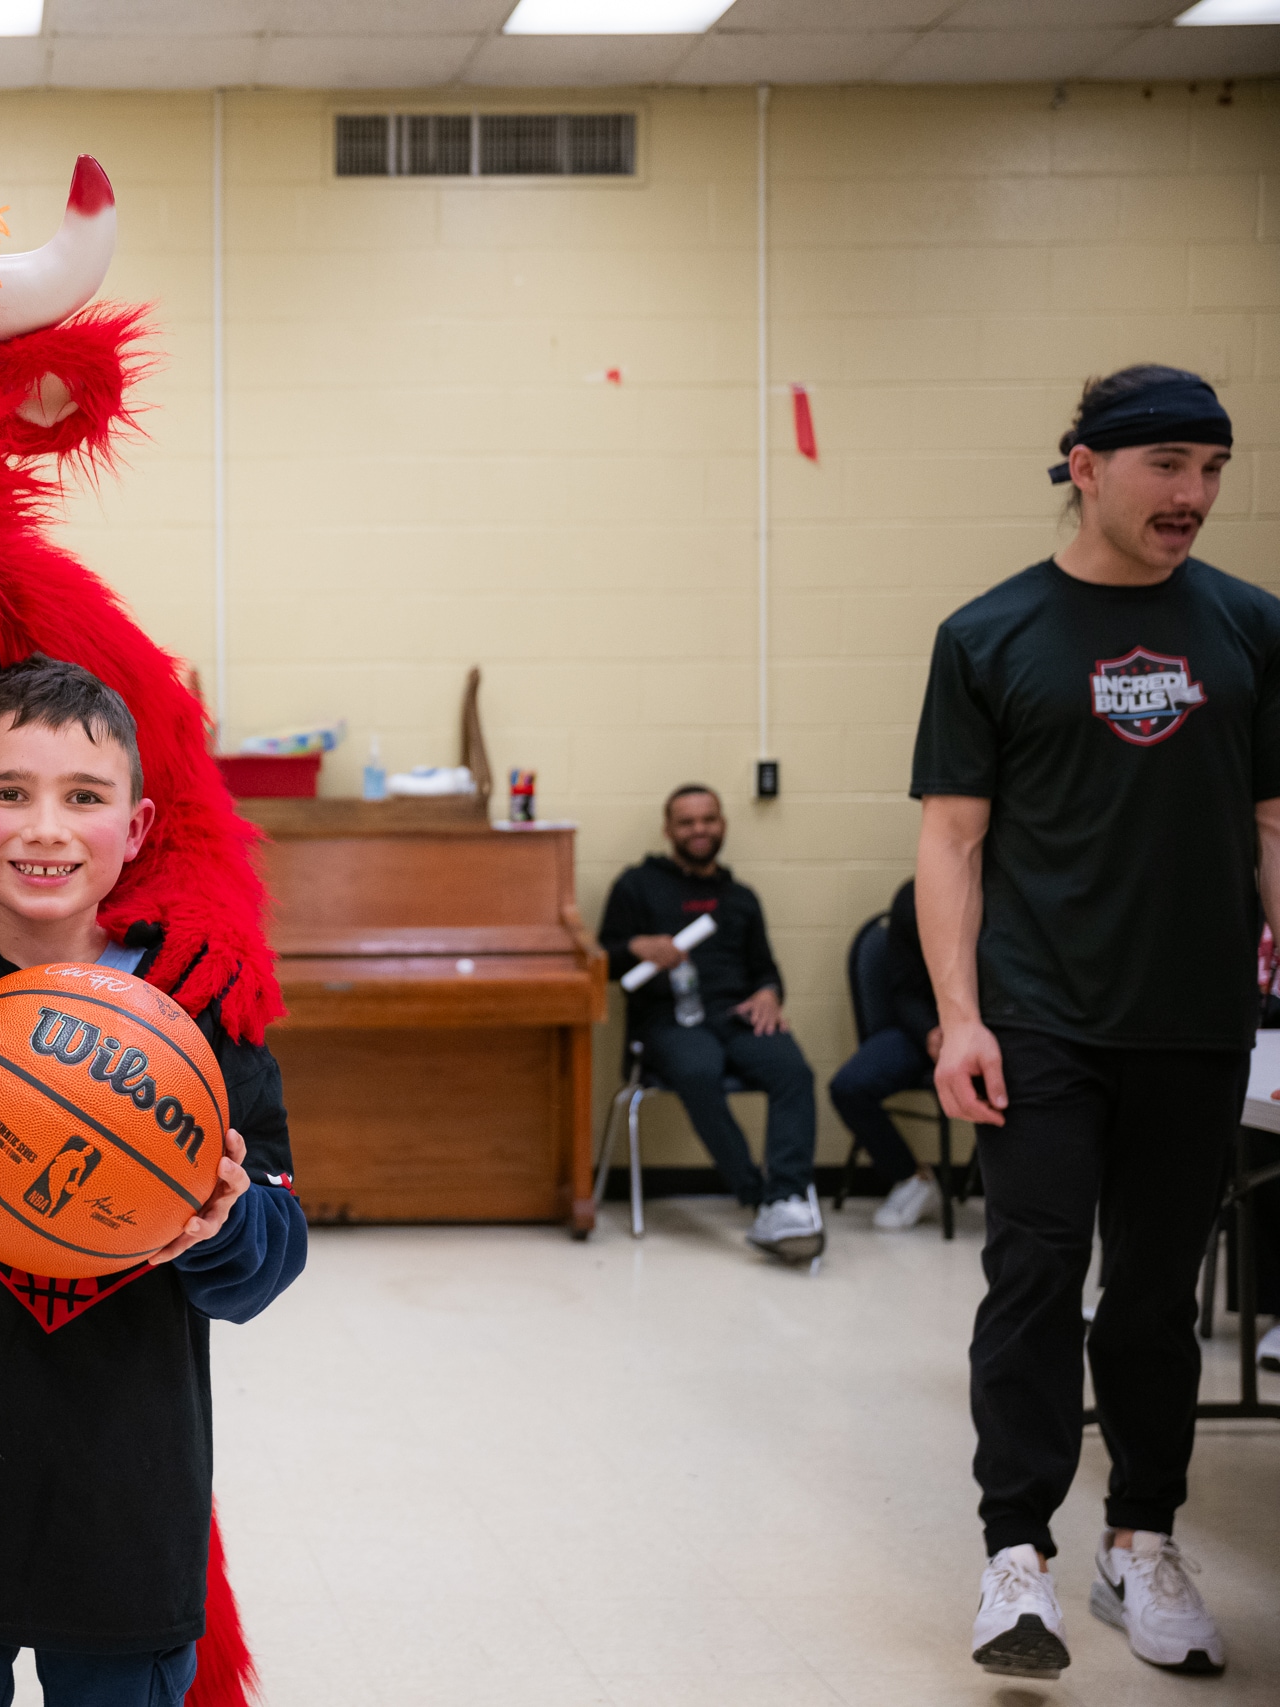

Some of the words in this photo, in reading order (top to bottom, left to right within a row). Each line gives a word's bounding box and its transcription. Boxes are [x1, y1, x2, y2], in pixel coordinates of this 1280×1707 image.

[1094, 689, 1168, 713] BULLS
[29, 1006, 205, 1165] Wilson
[16, 1142, 38, 1164] SERIES
[26, 1190, 50, 1211] NBA
